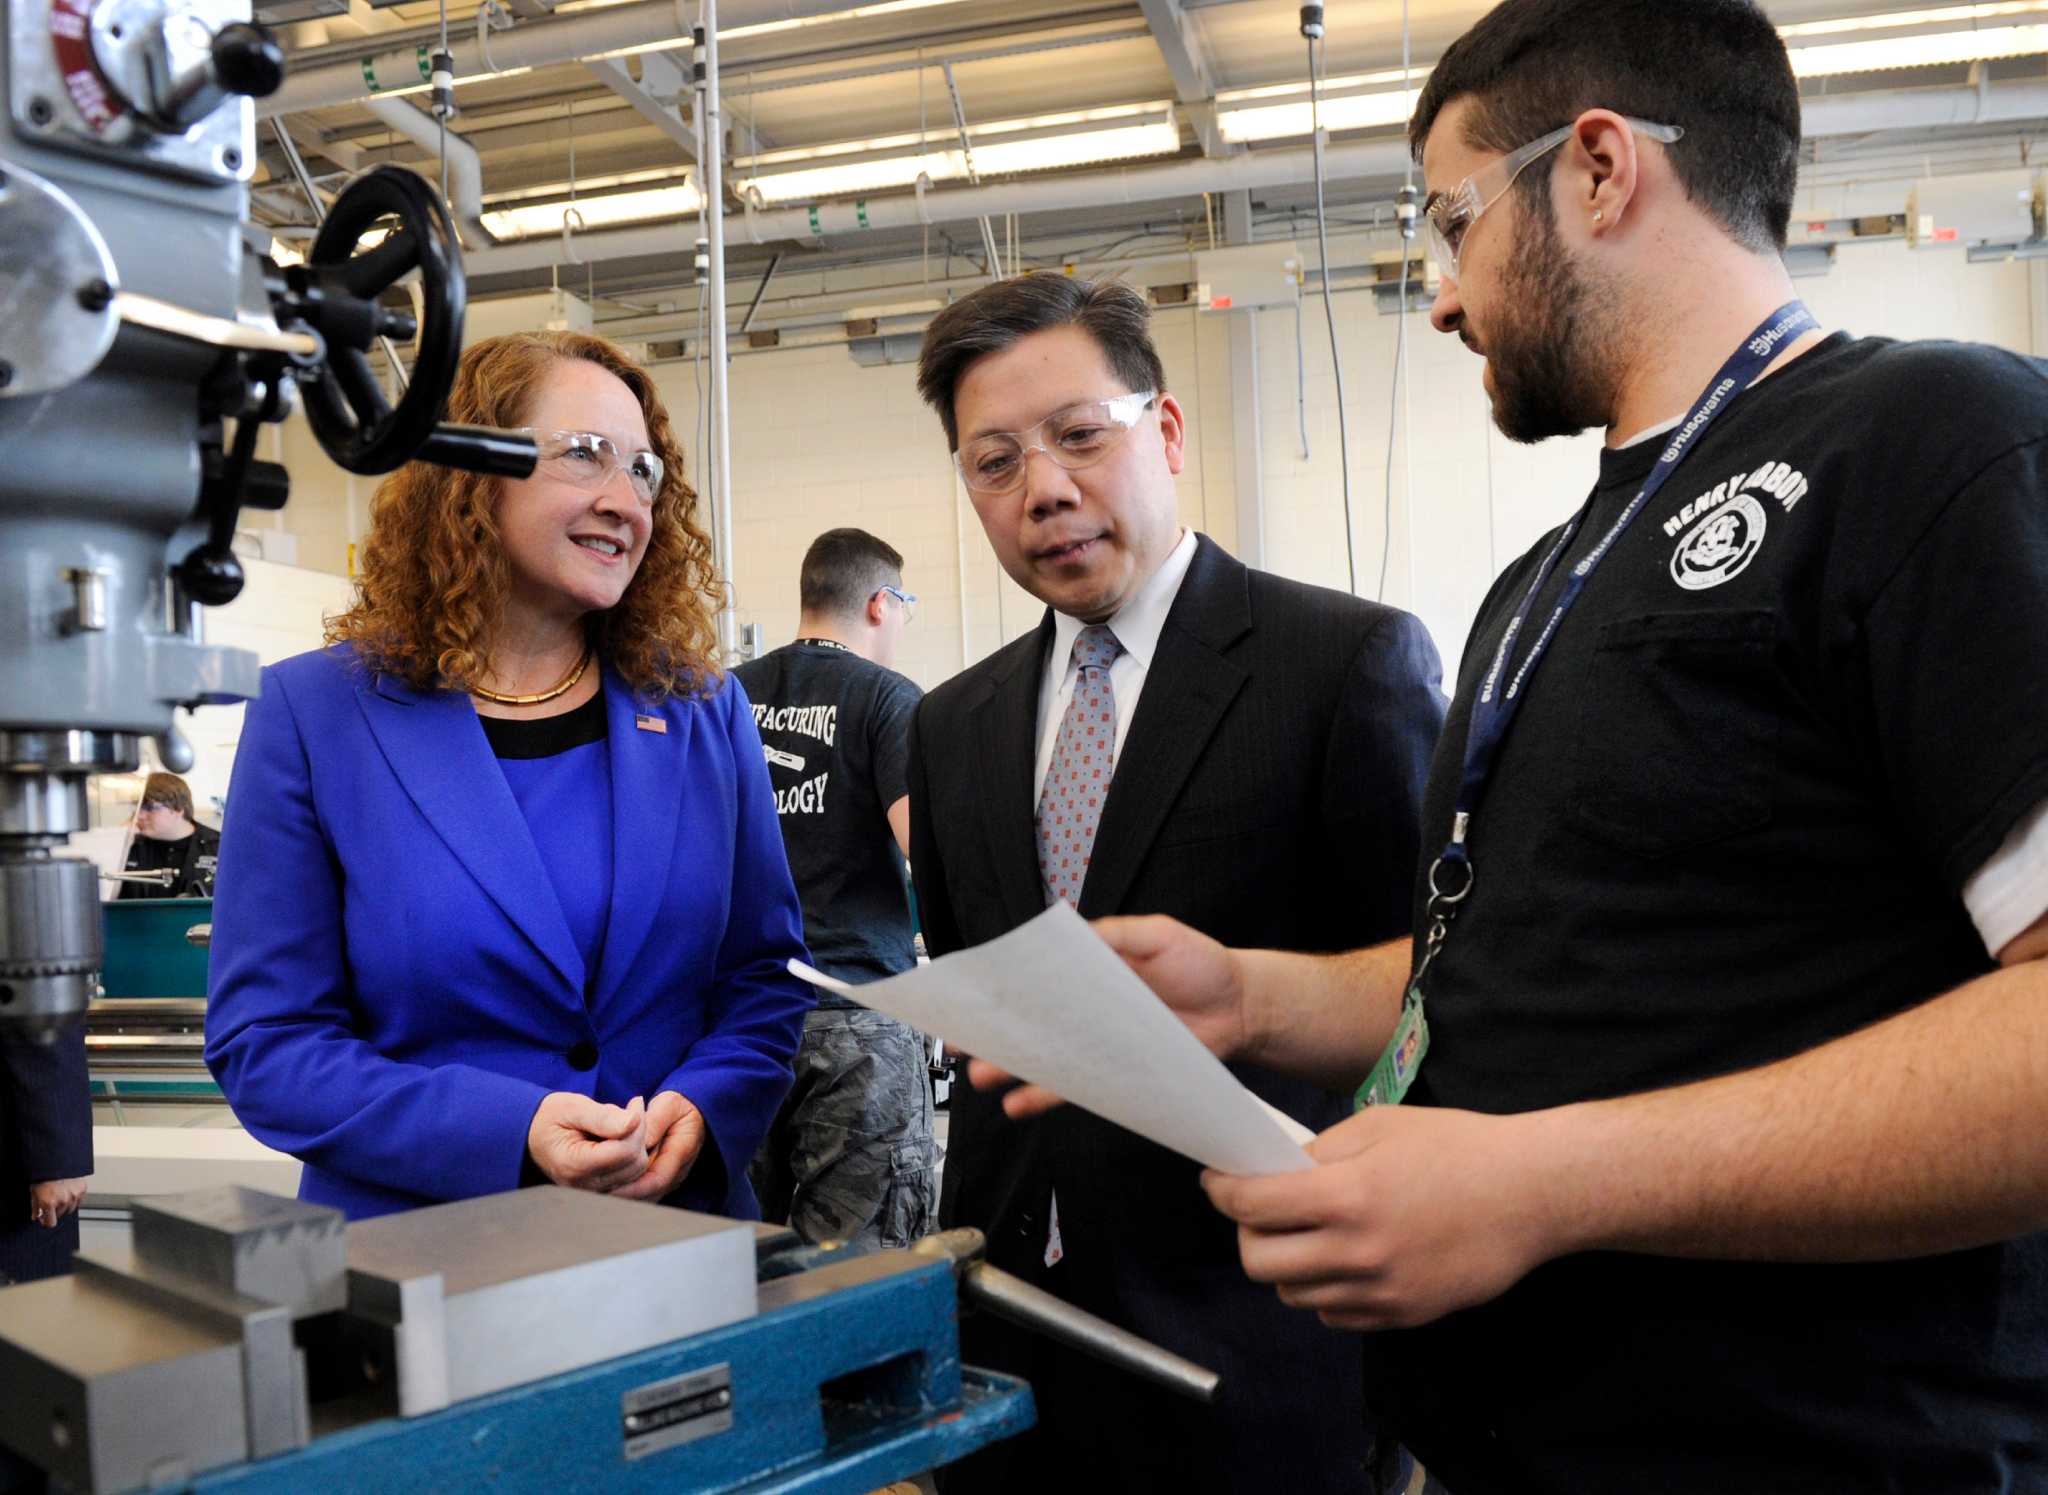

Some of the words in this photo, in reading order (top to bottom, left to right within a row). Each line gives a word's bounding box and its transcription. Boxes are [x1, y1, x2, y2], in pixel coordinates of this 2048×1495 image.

[1671, 377, 1736, 450] Husqvarna
[1663, 473, 1747, 537] HENRY
[773, 772, 828, 814] LOGY
